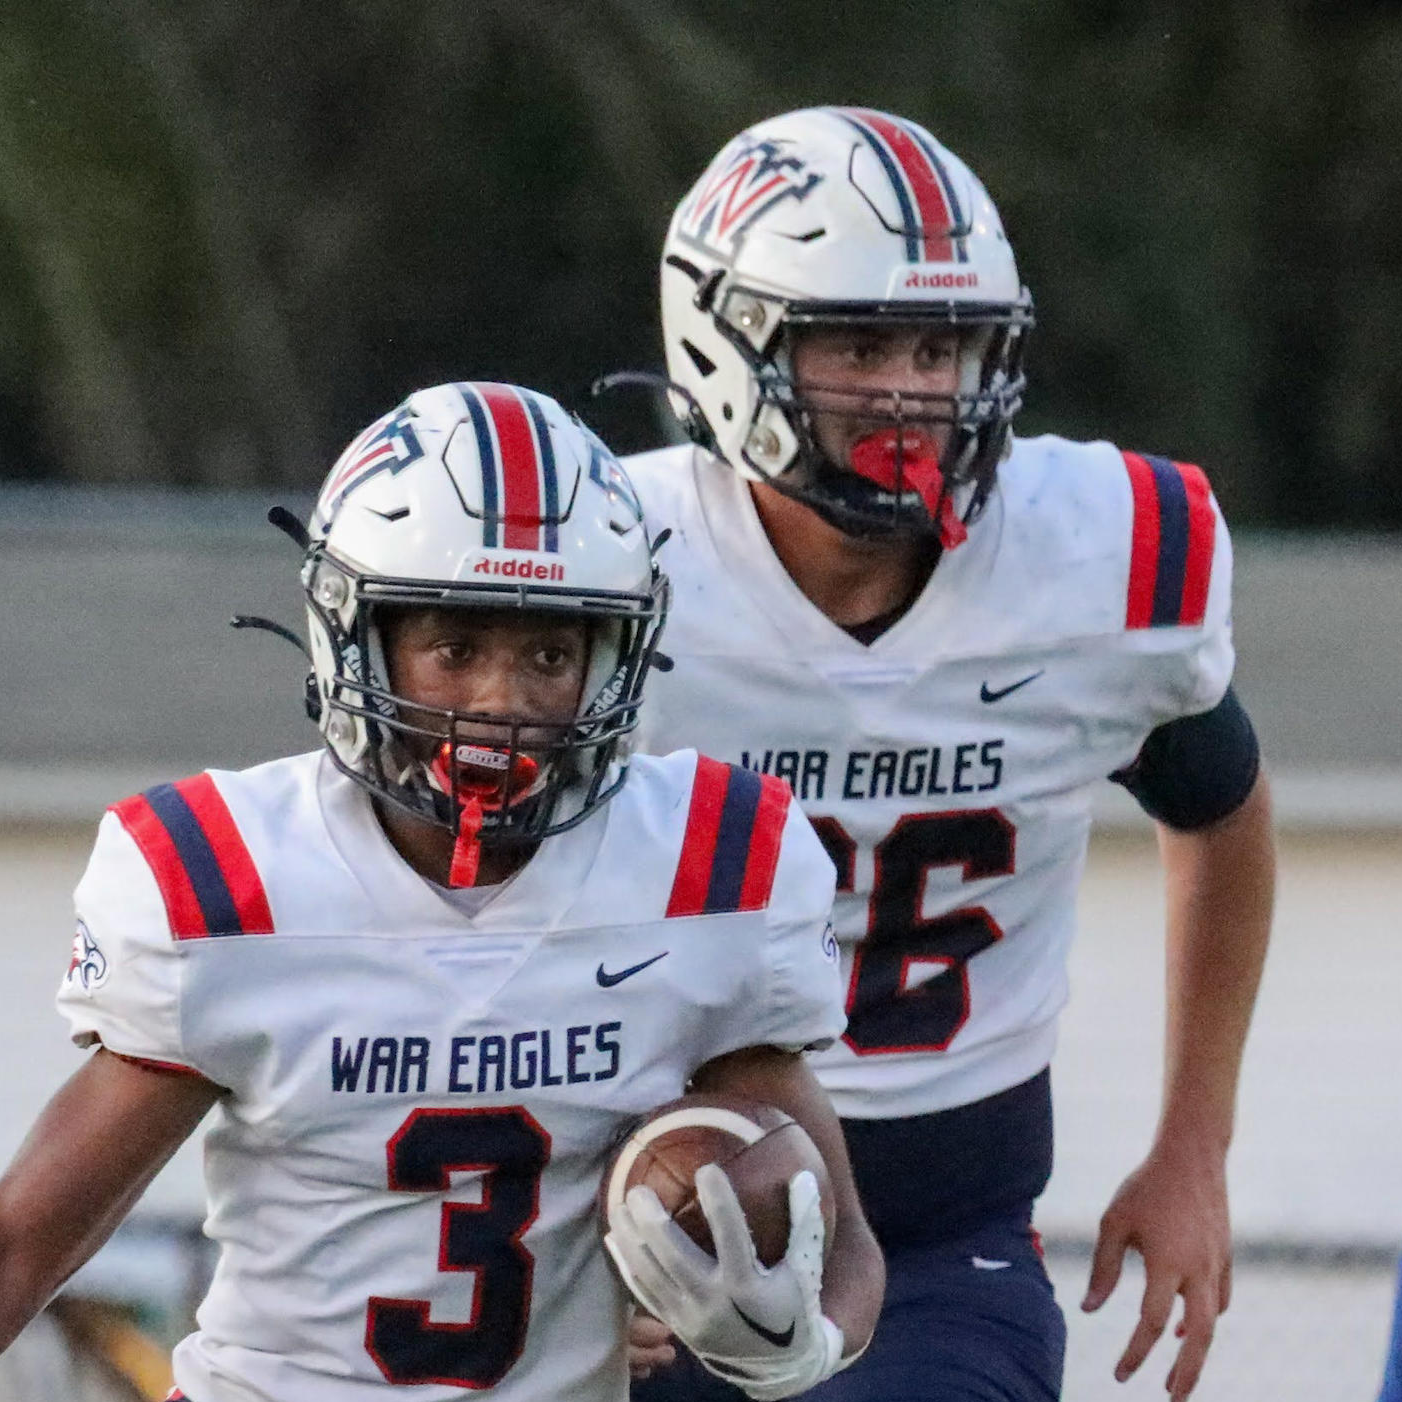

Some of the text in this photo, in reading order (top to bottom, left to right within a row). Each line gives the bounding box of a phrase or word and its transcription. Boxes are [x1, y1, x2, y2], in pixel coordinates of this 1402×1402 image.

[473, 557, 565, 581] Riddell
[741, 739, 1005, 800] WAR EAGLES
[331, 1020, 623, 1093] WAR EAGLES
[363, 1104, 552, 1390] 3
